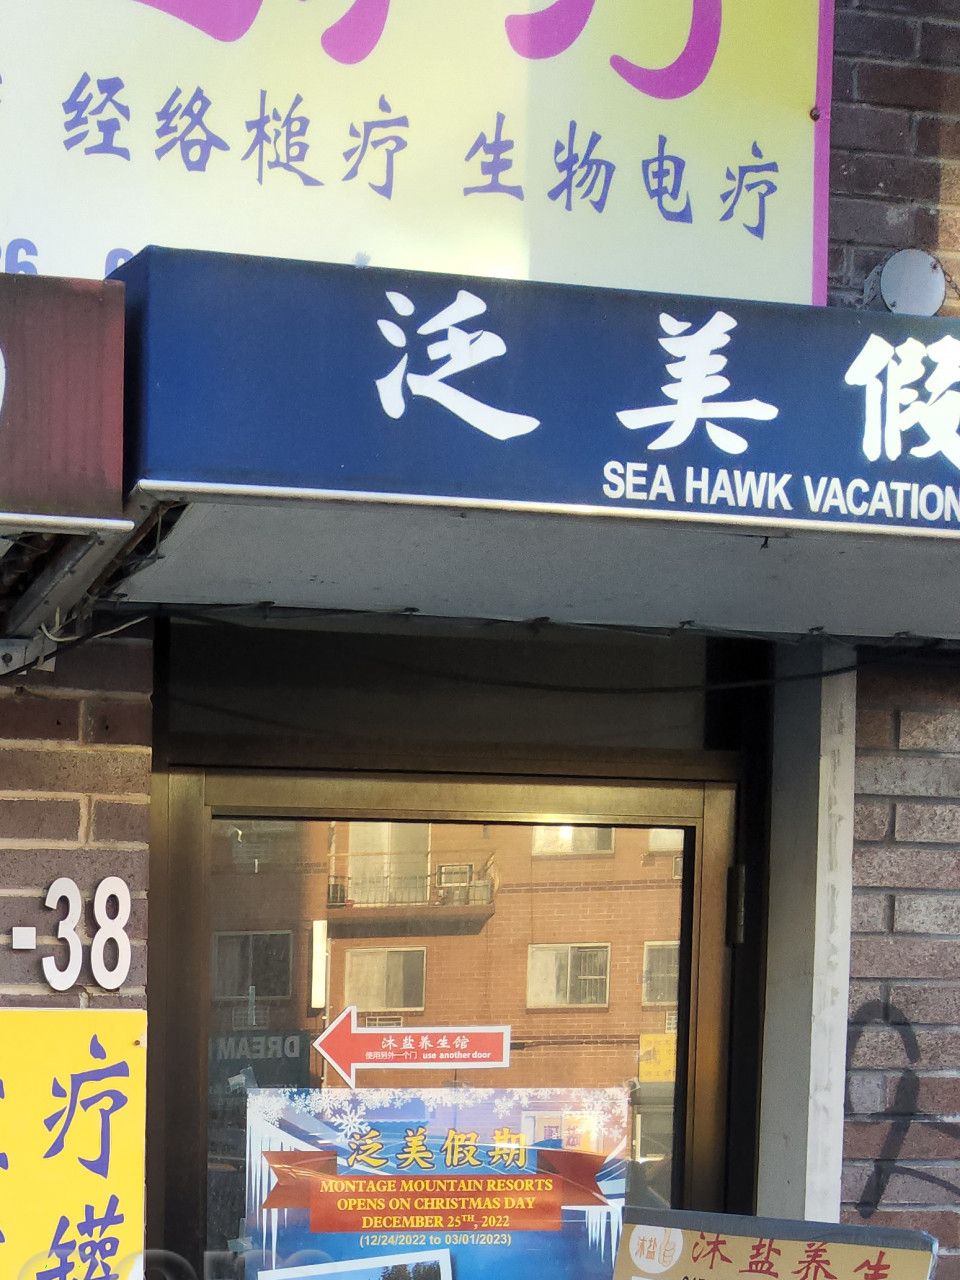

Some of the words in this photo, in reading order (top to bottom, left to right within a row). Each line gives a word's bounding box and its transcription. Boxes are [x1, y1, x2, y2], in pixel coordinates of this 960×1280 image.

[61, 70, 410, 200] 经络槌疗
[463, 111, 780, 240] 生物电疗
[603, 460, 675, 502] SEA
[686, 466, 793, 510] HAWK
[381, 1035, 470, 1050] 沐盐养生馆
[423, 1052, 437, 1060] use
[440, 1051, 471, 1060] another
[472, 1051, 491, 1060] door
[347, 1126, 529, 1170] 泛美假期
[320, 1179, 397, 1193] MONTAGE
[400, 1178, 483, 1193] MOUNTAIN
[487, 1178, 553, 1192] RESORTS
[337, 1197, 386, 1211] OPENS
[388, 1197, 411, 1210] ON
[414, 1196, 501, 1210] CHRISTMAS
[504, 1196, 536, 1210] DAY
[362, 1215, 444, 1229] DECEMBER
[481, 1215, 510, 1228] 2022
[359, 1233, 426, 1248] (12/24/2022
[429, 1234, 441, 1246] to
[444, 1233, 512, 1247] 03/01/2023)
